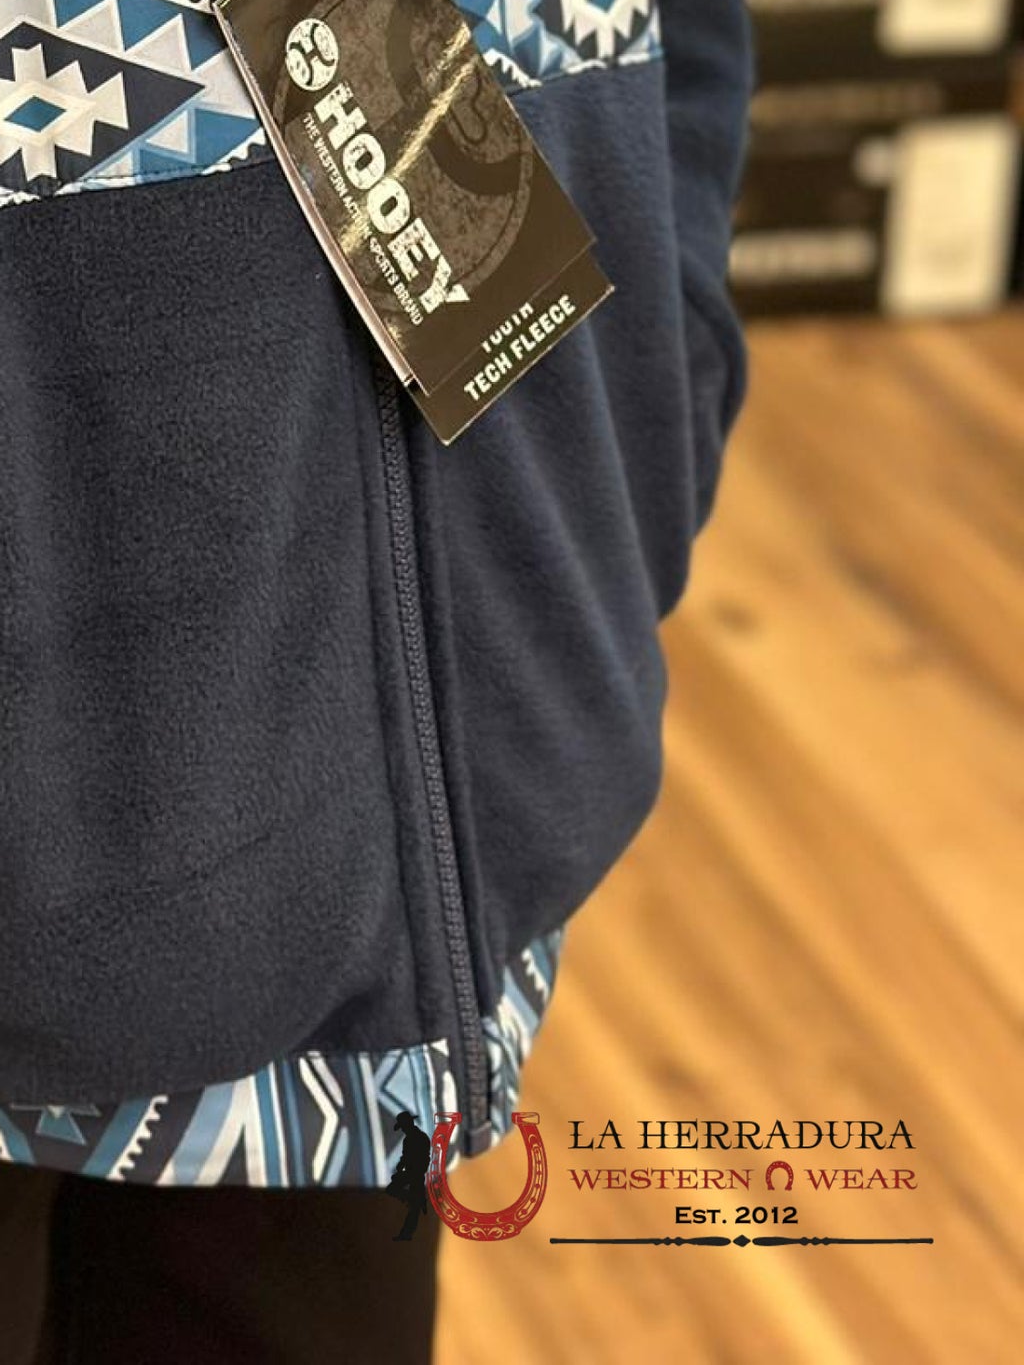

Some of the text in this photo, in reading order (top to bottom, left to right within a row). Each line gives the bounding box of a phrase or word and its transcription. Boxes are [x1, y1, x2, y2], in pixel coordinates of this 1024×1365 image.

[303, 112, 321, 141] THE
[314, 137, 348, 197] WESTERN
[370, 237, 399, 286] SPORTS
[394, 282, 424, 325] BRAND
[313, 80, 470, 314] HOOEY
[464, 294, 576, 401] TECH FLEECE
